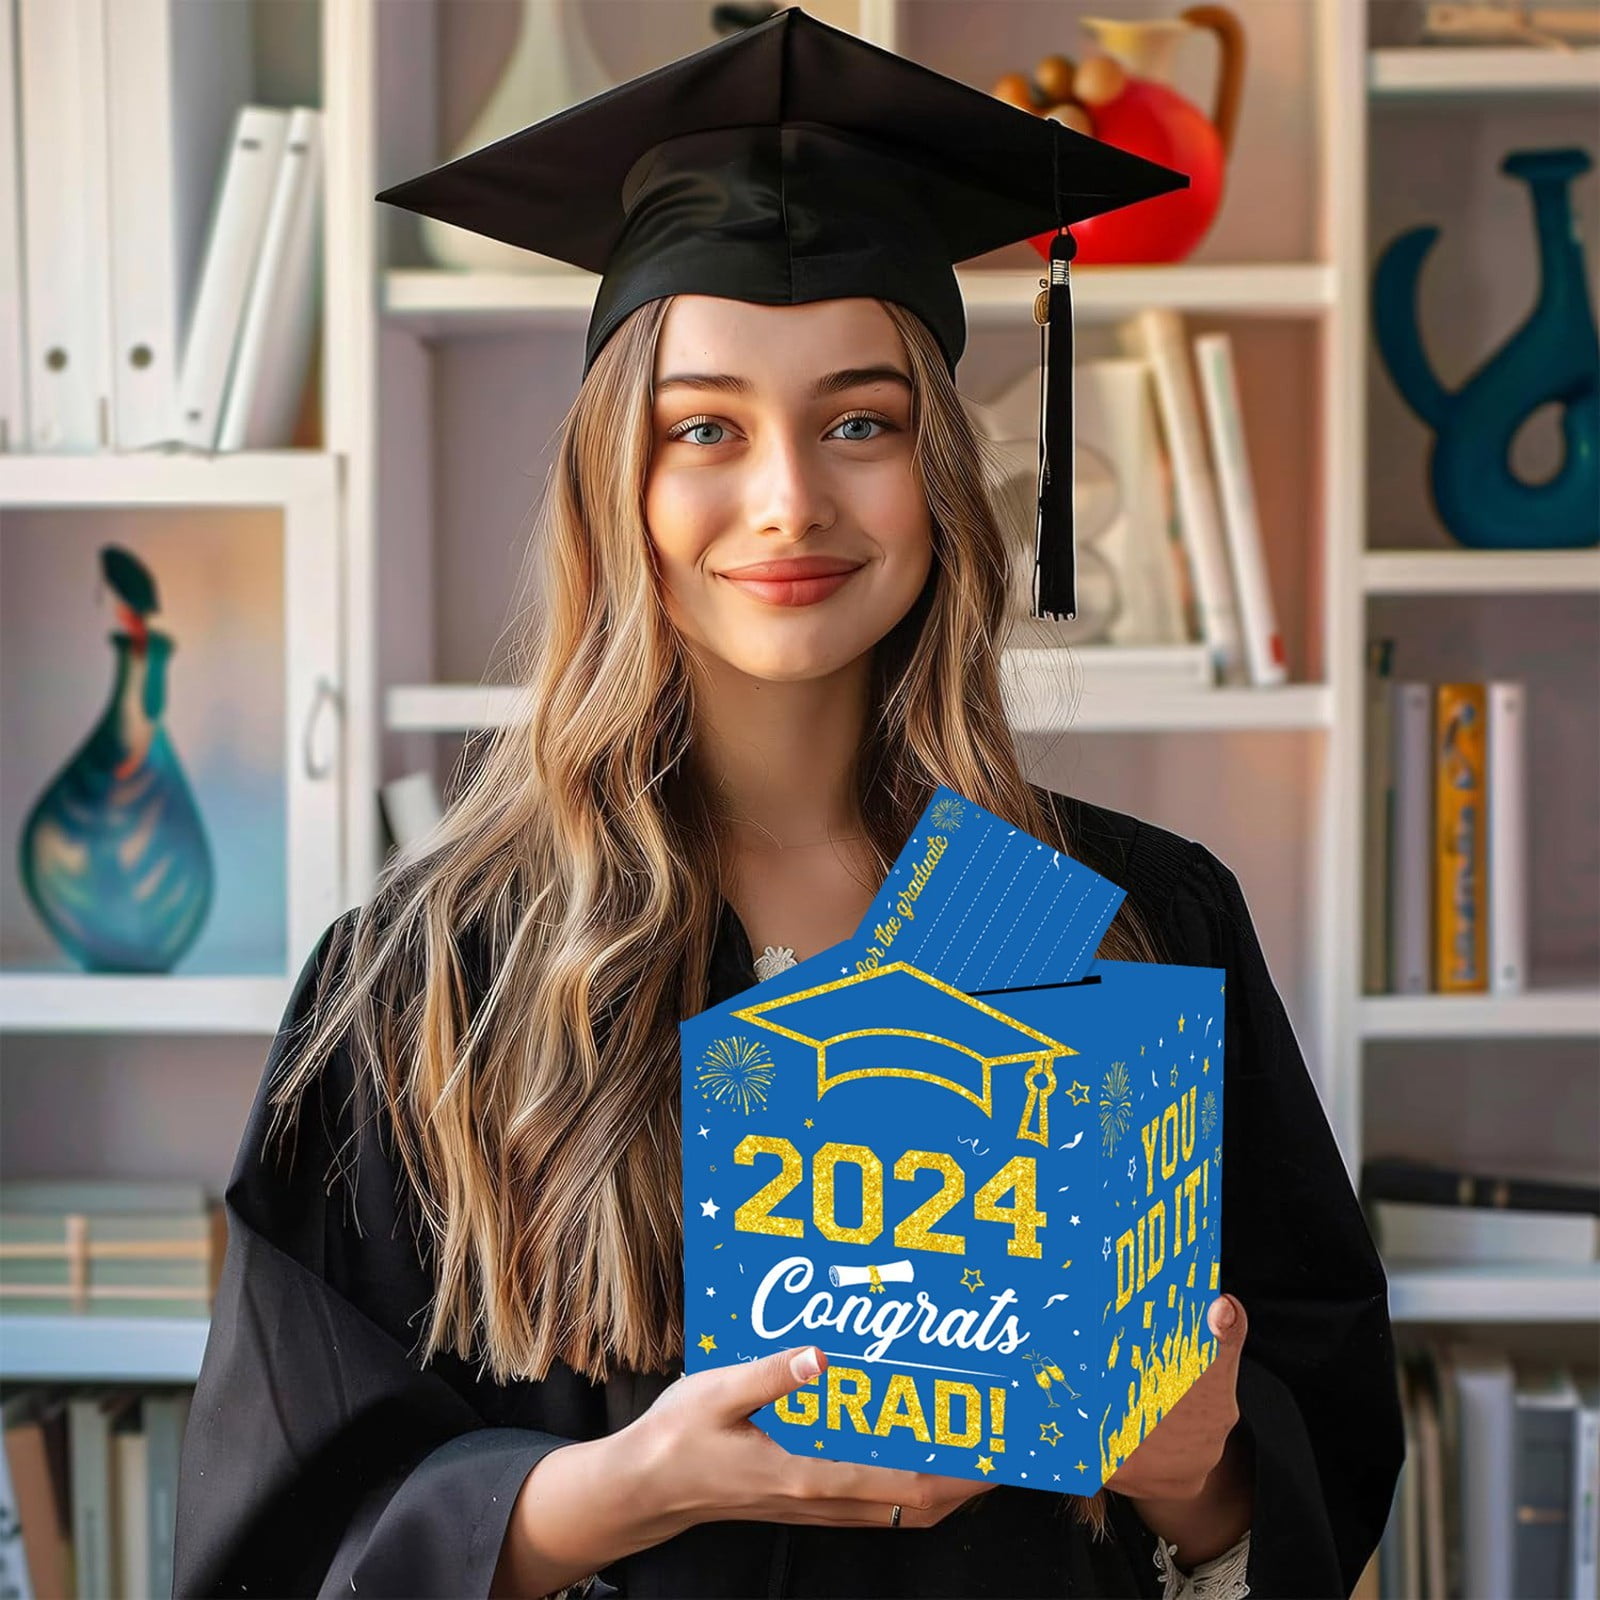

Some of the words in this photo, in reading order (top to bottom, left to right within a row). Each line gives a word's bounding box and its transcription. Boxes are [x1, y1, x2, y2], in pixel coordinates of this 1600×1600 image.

[874, 916, 902, 947] the
[896, 834, 949, 920] graduate
[733, 1133, 1048, 1260] 2024
[1141, 1085, 1197, 1197] YOU
[1115, 1205, 1168, 1314] DID
[1173, 1158, 1209, 1258] IT!
[750, 1256, 1031, 1363] Congrats
[774, 1365, 1006, 1453] GRAD!
